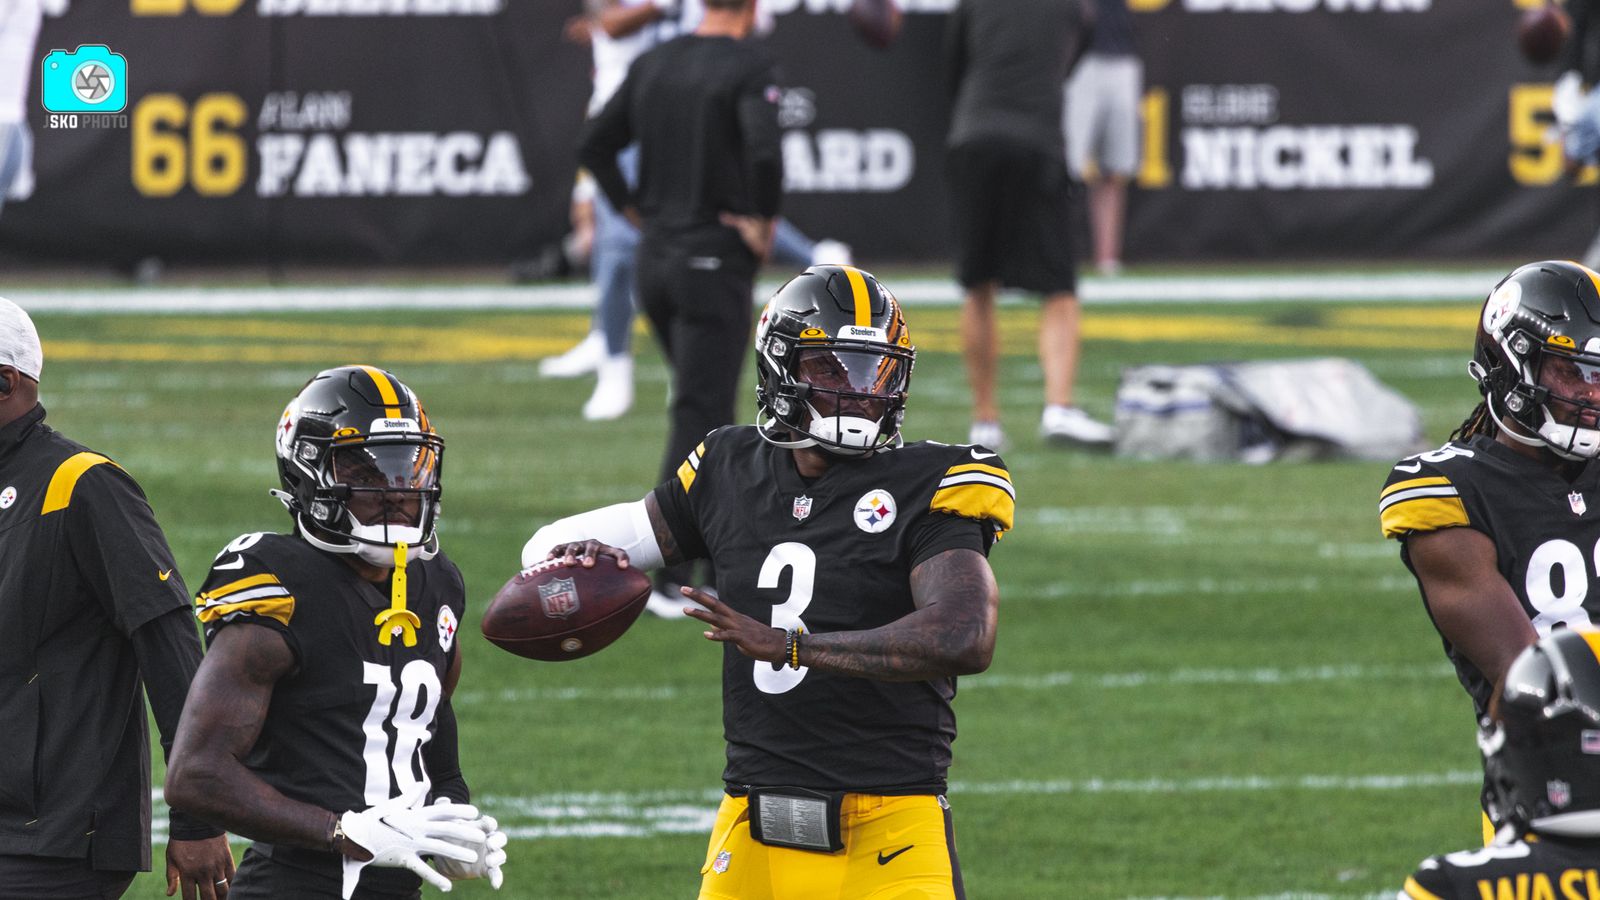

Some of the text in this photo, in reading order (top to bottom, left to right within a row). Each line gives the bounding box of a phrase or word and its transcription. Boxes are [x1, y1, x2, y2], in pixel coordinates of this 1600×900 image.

[132, 94, 247, 196] 66
[257, 133, 530, 196] FANECA
[781, 129, 914, 192] ARD
[1138, 89, 1171, 188] 1
[1182, 125, 1434, 189] NICKEL
[850, 327, 876, 336] Steelers
[384, 420, 409, 428] Steelers
[547, 592, 574, 613] NFL
[752, 541, 817, 694] 3
[1525, 538, 1600, 640] 8
[362, 659, 442, 809] 18
